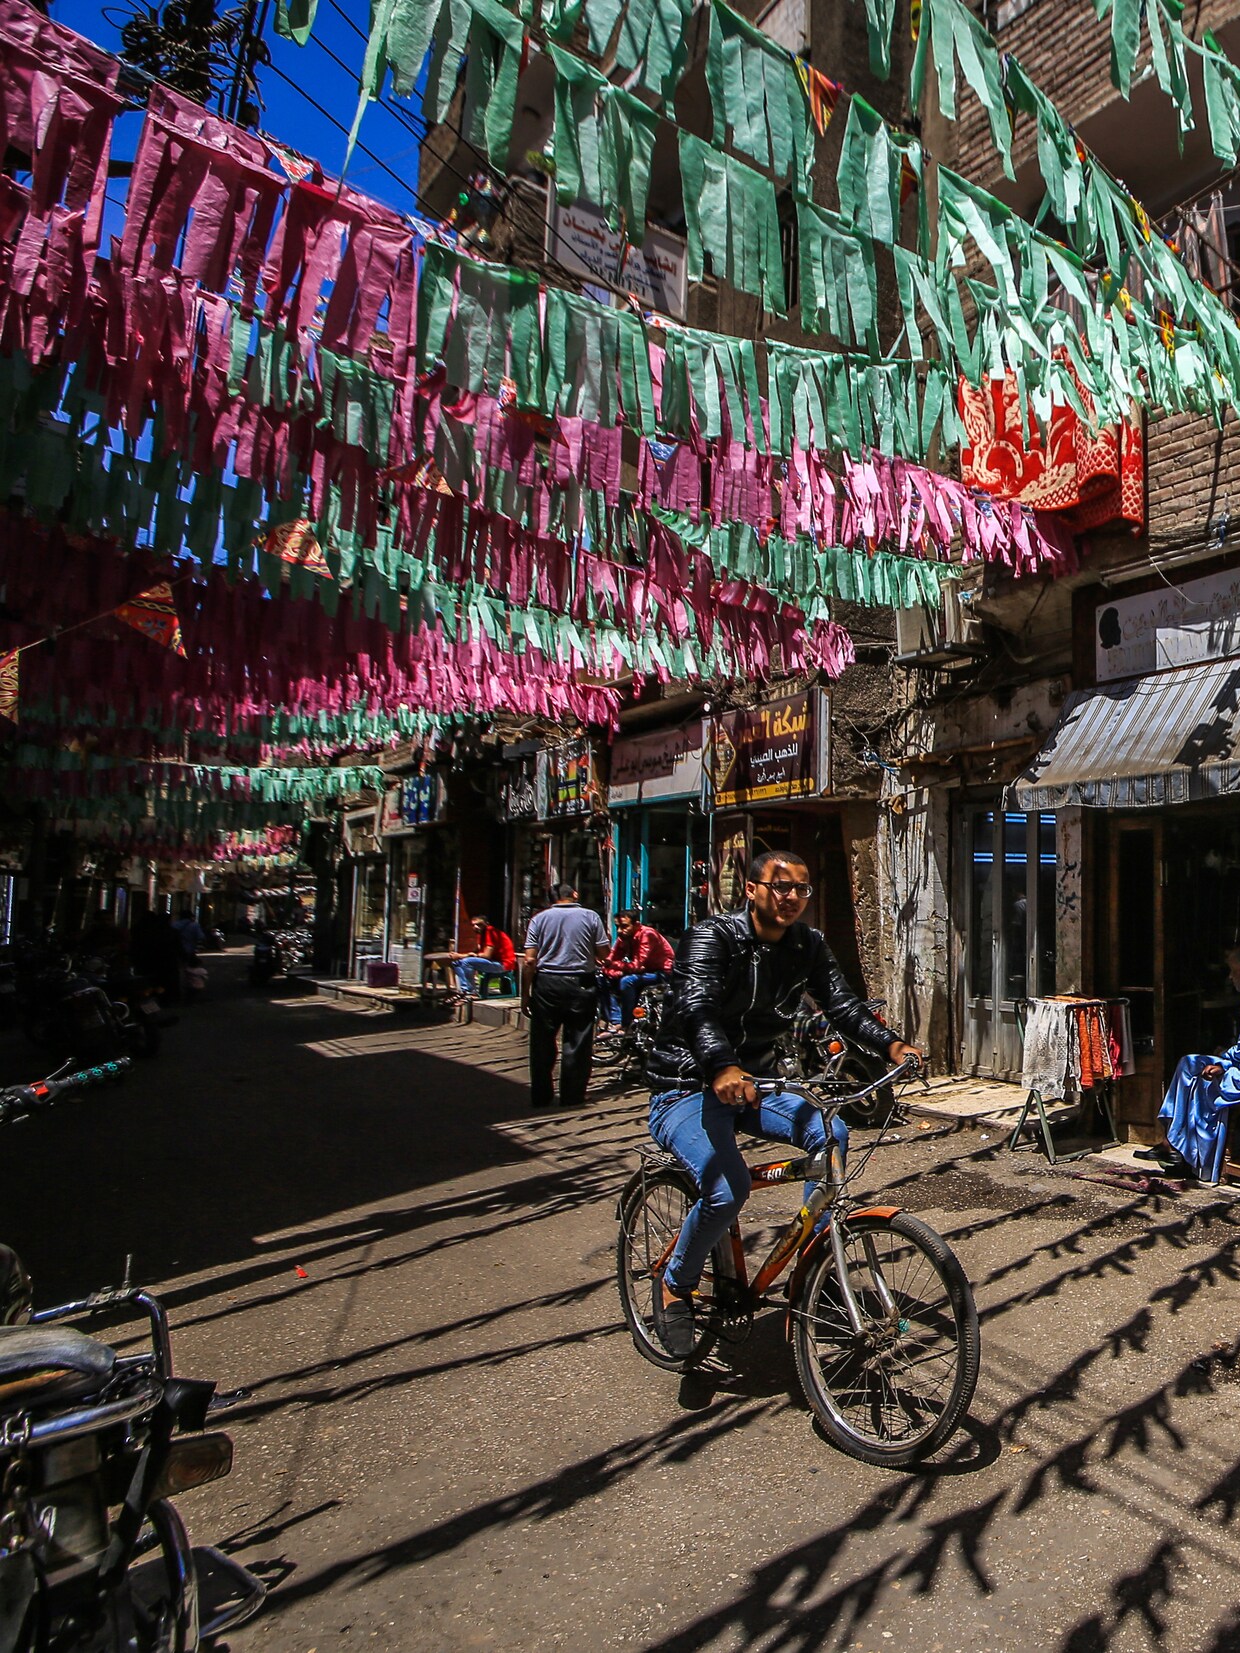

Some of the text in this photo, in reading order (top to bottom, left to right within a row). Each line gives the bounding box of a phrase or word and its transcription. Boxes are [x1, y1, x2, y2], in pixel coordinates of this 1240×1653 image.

[773, 701, 807, 740] شبكة
[749, 743, 798, 769] للذهب الصيني
